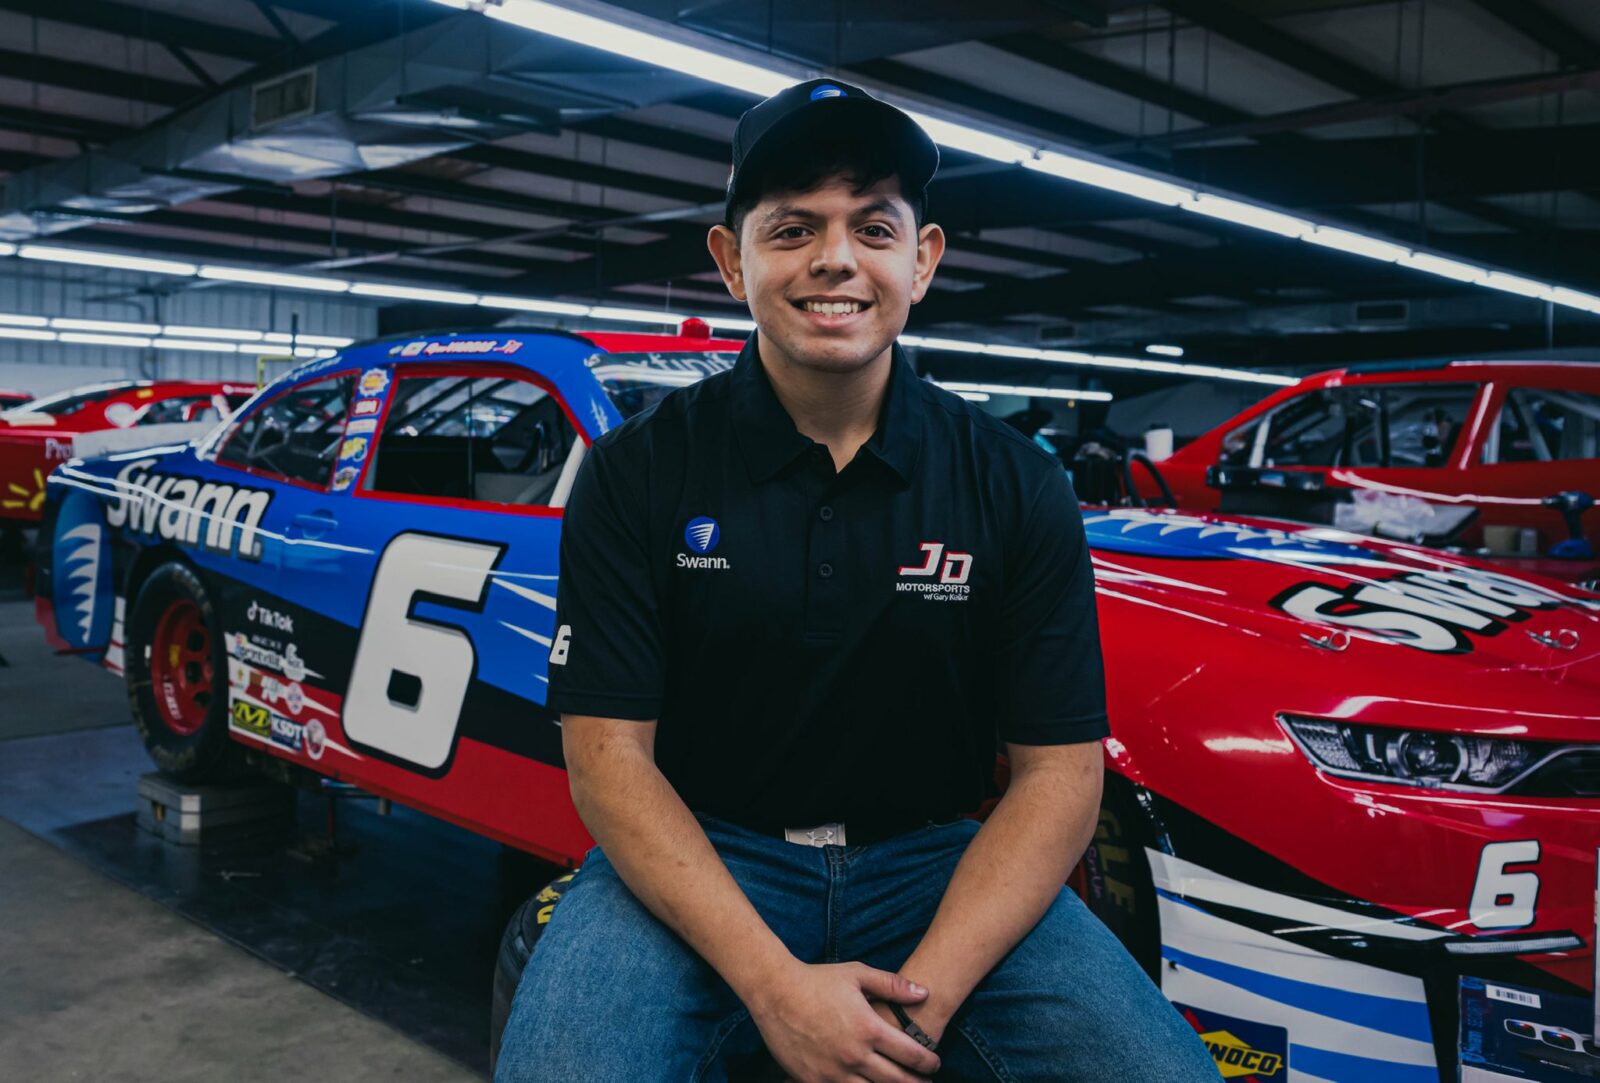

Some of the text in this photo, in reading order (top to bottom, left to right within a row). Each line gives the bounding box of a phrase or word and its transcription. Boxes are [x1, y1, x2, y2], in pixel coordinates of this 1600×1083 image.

[896, 541, 974, 585] JD
[896, 582, 970, 594] MOTORSPORTS
[933, 593, 949, 602] Gary
[258, 607, 294, 633] TikTok
[342, 531, 502, 772] 6
[549, 624, 571, 666] 6
[1469, 839, 1540, 929] 6
[1205, 1041, 1278, 1074] NOCO
